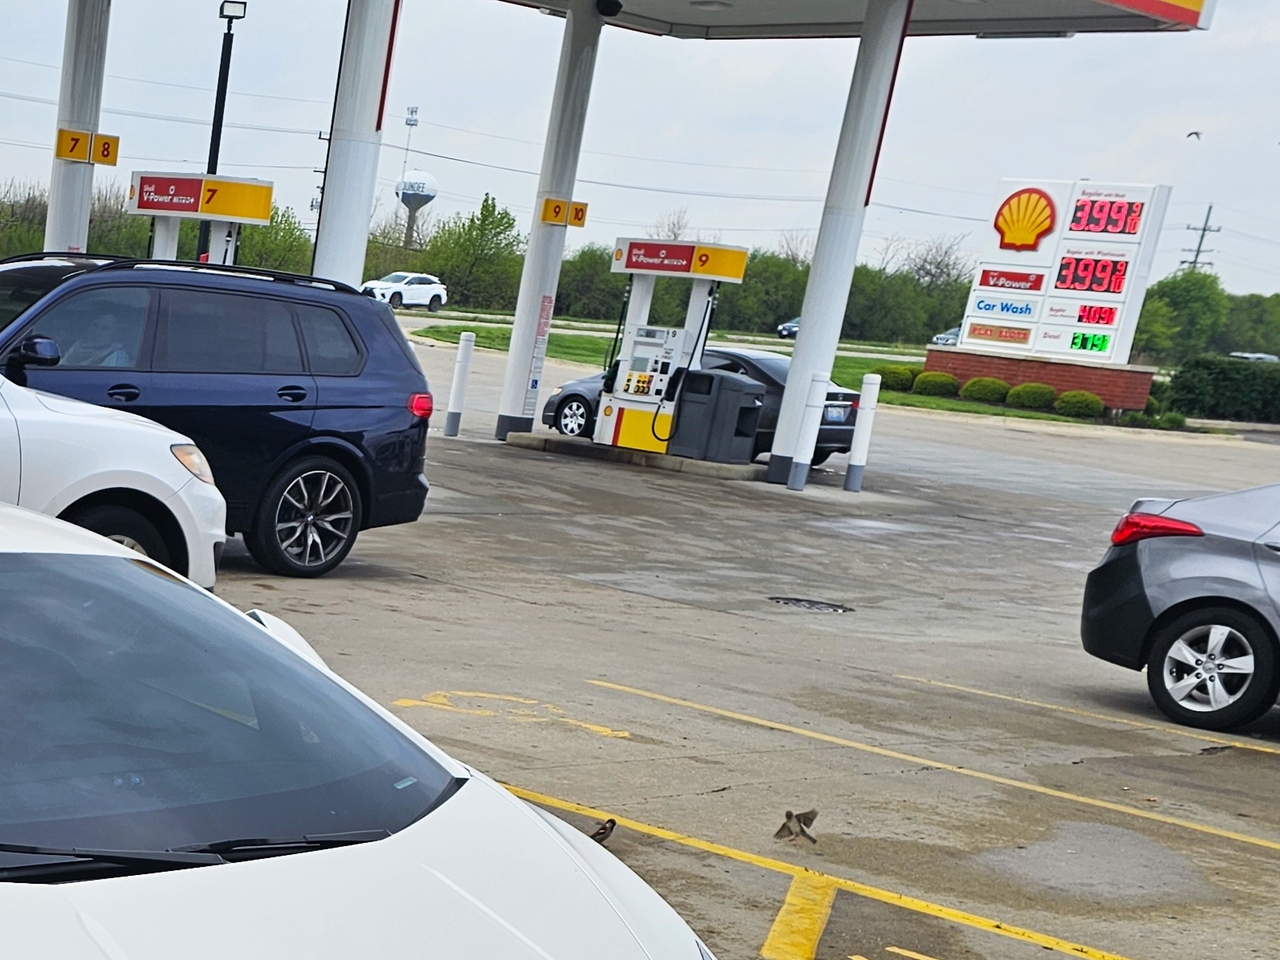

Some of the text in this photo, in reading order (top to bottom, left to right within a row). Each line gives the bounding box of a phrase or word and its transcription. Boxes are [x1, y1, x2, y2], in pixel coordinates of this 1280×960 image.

[69, 137, 81, 153] 7
[101, 141, 111, 158] 8
[143, 191, 172, 203] V-Power
[204, 188, 219, 205] 7
[553, 205, 562, 218] 9
[573, 207, 584, 222] 10
[1070, 199, 1129, 232] 3.99
[632, 254, 663, 264] V-Power
[698, 253, 710, 268] 9
[1055, 256, 1114, 291] 3.99
[988, 276, 1033, 289] V-Power
[977, 300, 1032, 315] Car Wash
[671, 330, 677, 338] 9
[971, 326, 1029, 340] PLAY SLOTS
